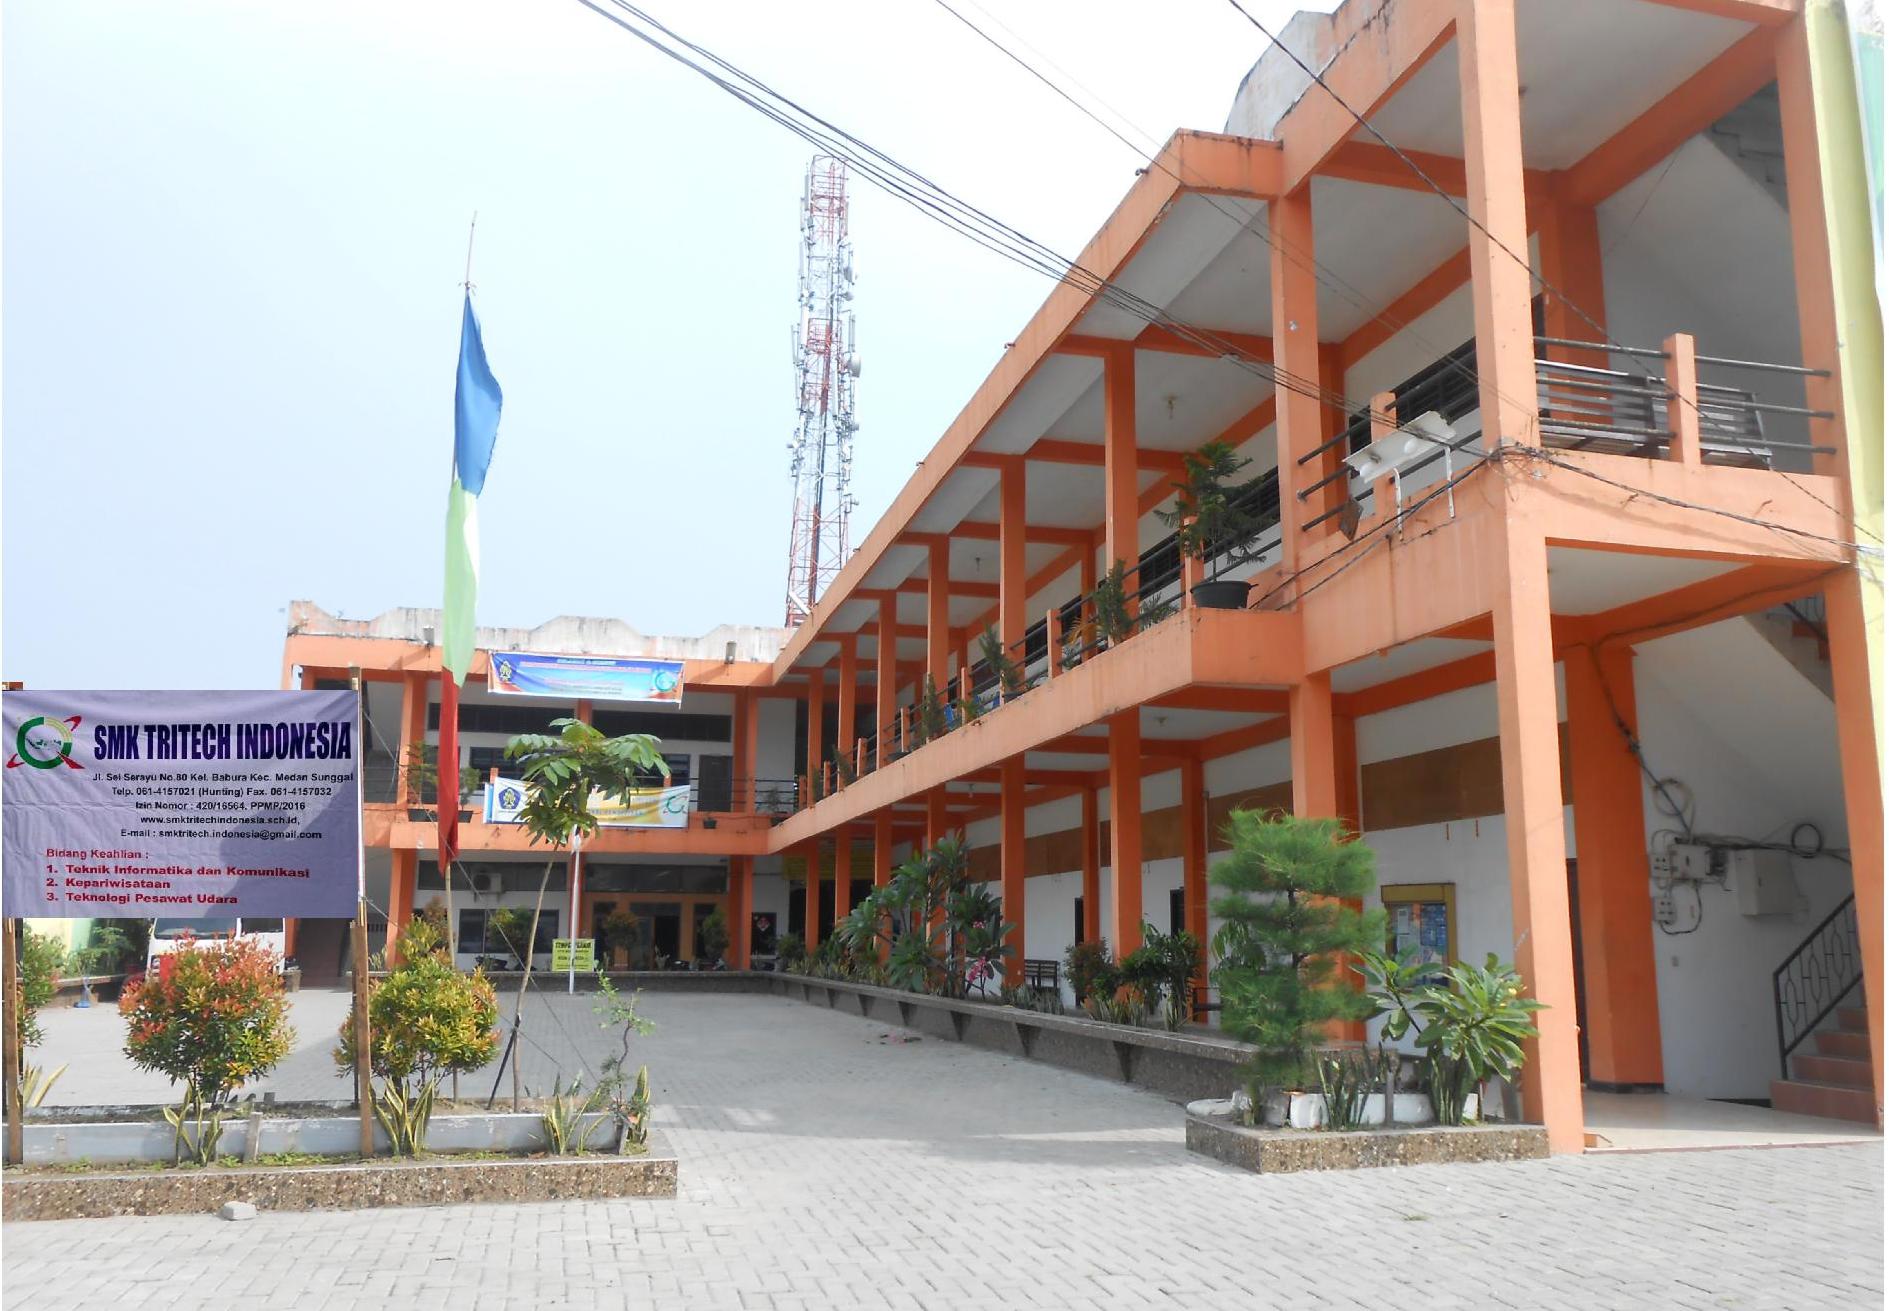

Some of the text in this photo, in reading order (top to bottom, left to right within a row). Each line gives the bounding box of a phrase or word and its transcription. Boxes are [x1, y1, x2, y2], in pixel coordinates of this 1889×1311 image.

[94, 721, 352, 760] SMK TRITECH INDONESIA
[106, 773, 121, 782] Sei
[123, 773, 157, 783] Serayu
[159, 773, 188, 782] No.80
[190, 773, 209, 782] Kel.
[211, 773, 247, 782] Babura
[249, 773, 272, 782] Kec.
[275, 773, 308, 782] Medan
[311, 773, 354, 784] Sunggal
[112, 787, 332, 798] Telp. 061-4157021 (Hunting) Fax. 061-4157032
[135, 802, 153, 810] Izin
[155, 802, 187, 811] Nomor
[250, 802, 306, 811] PPMP/2016
[121, 829, 150, 838] E-mail
[159, 830, 323, 841] smktritech.indonesia@gmail.com
[46, 848, 87, 860] Bidang
[91, 850, 142, 859] Keahlian
[46, 865, 310, 878] 1. Teknik Informatika dan Komunikasi
[46, 878, 171, 889] 2. Kepariwisataan
[46, 892, 238, 904] 3. Teknologi Pesawat Udara
